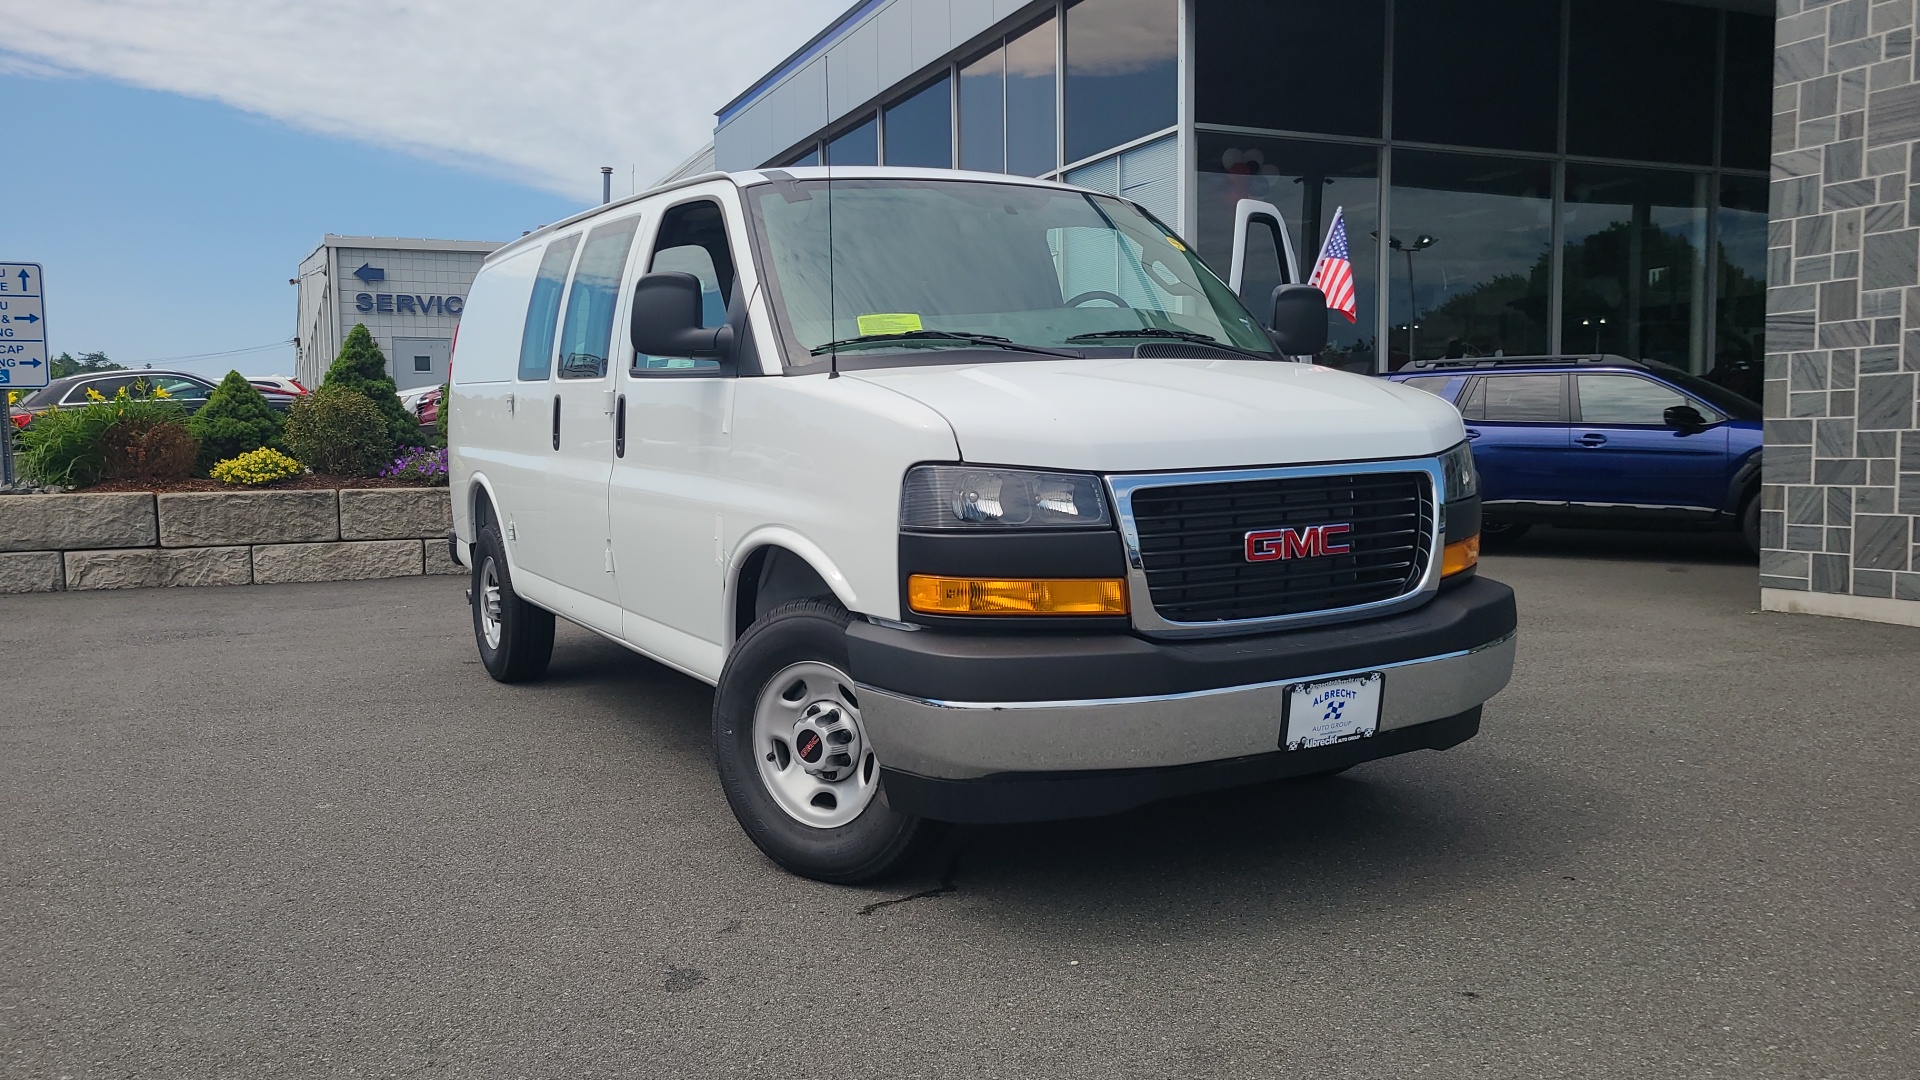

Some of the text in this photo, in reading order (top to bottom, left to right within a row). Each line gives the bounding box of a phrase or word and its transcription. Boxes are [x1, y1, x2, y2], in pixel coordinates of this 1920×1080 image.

[0, 282, 9, 292] E
[355, 293, 463, 316] SERVIC
[2, 314, 11, 324] &
[0, 345, 24, 354] CAP
[1245, 523, 1350, 563] GMC
[1312, 688, 1357, 708] ALBRECHT
[1312, 723, 1330, 733] AUTO
[1330, 720, 1352, 729] GROUP
[800, 734, 820, 758] GMC
[1303, 734, 1338, 749] Albrecht
